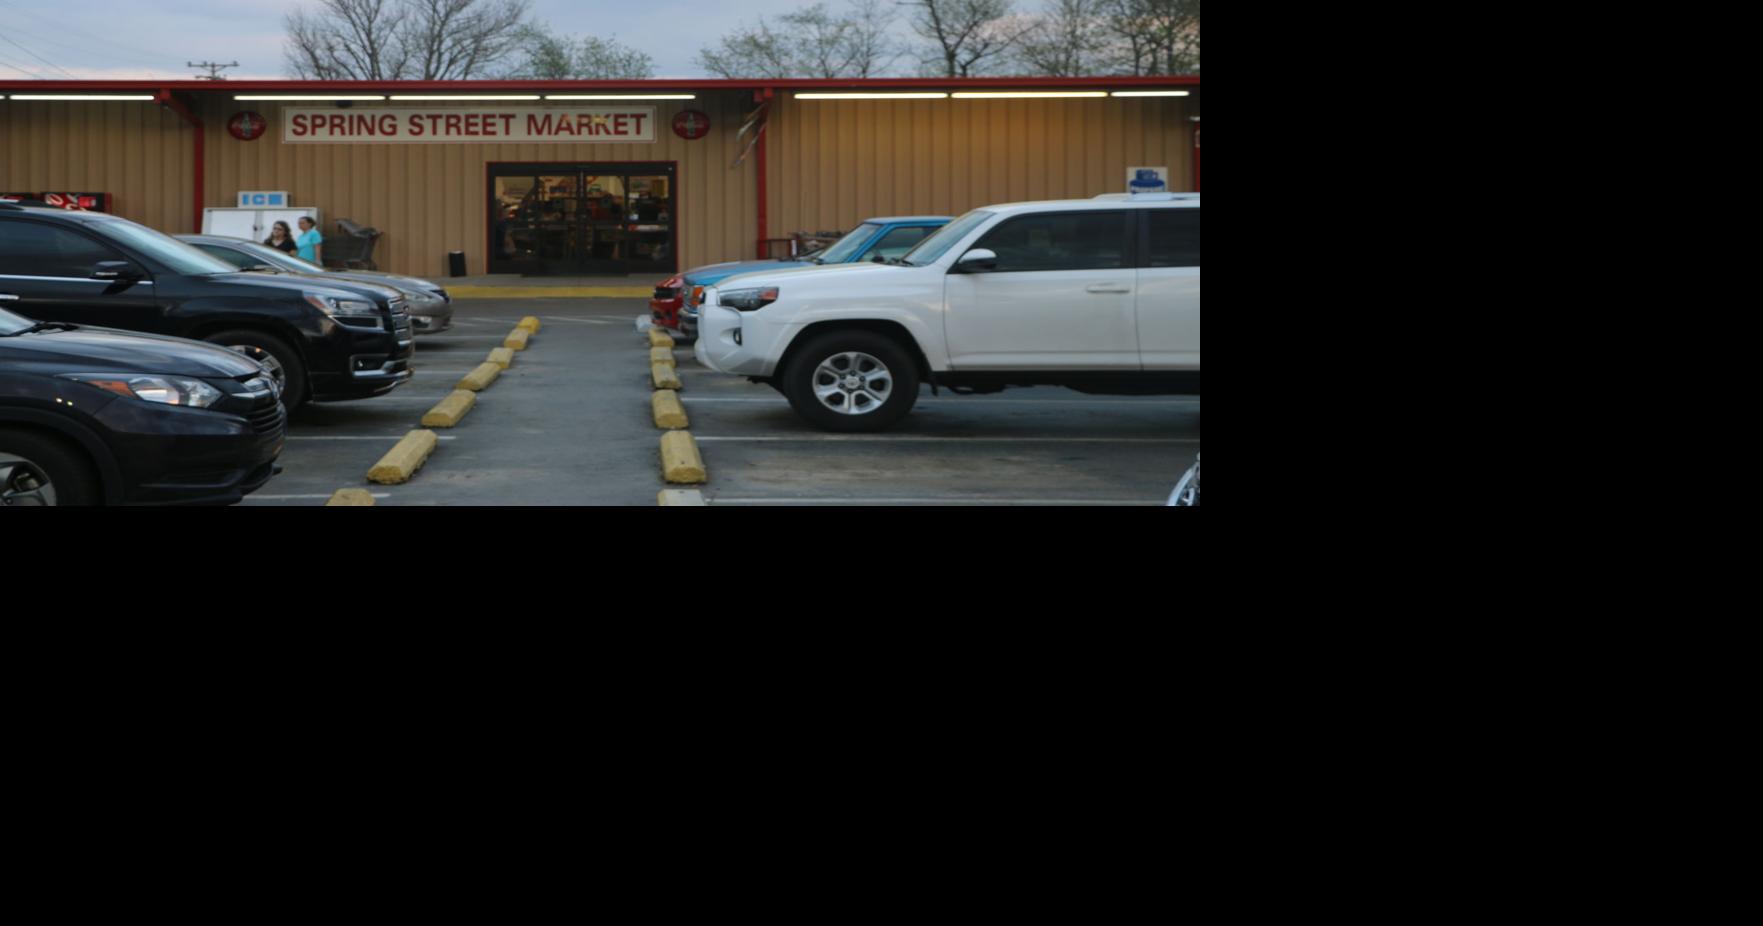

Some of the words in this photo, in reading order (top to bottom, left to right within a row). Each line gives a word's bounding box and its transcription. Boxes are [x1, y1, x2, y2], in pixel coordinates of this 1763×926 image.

[291, 113, 398, 137] SPRING
[407, 113, 517, 137] STREET
[526, 113, 648, 136] MARKET
